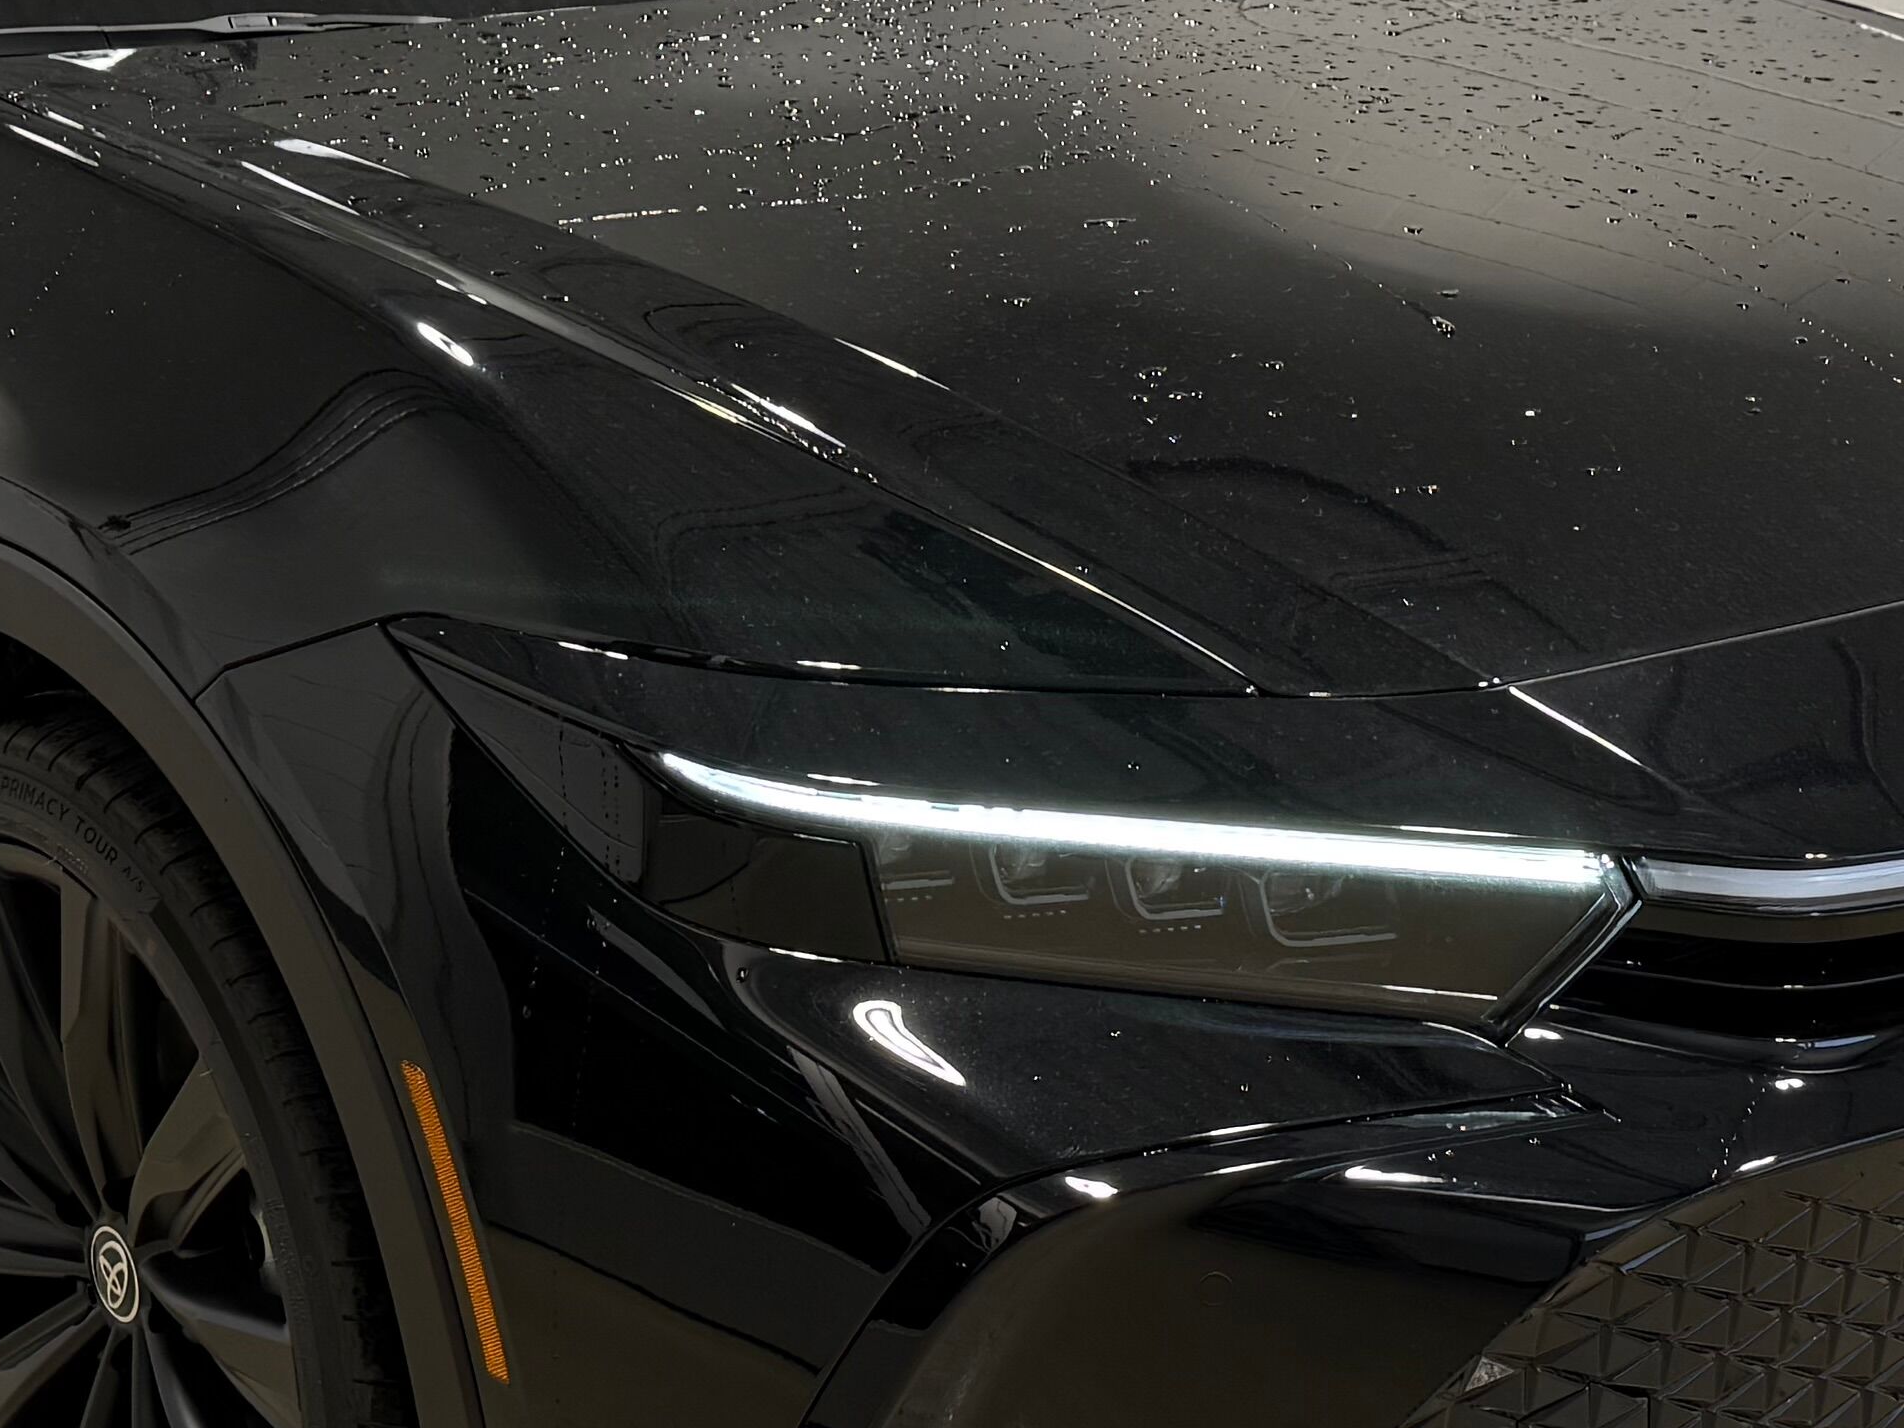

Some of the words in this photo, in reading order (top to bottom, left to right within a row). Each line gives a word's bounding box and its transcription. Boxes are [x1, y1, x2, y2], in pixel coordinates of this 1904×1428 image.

[1, 775, 69, 821] PRIMACY
[74, 817, 118, 866] TOUR
[123, 865, 145, 893] A/S
